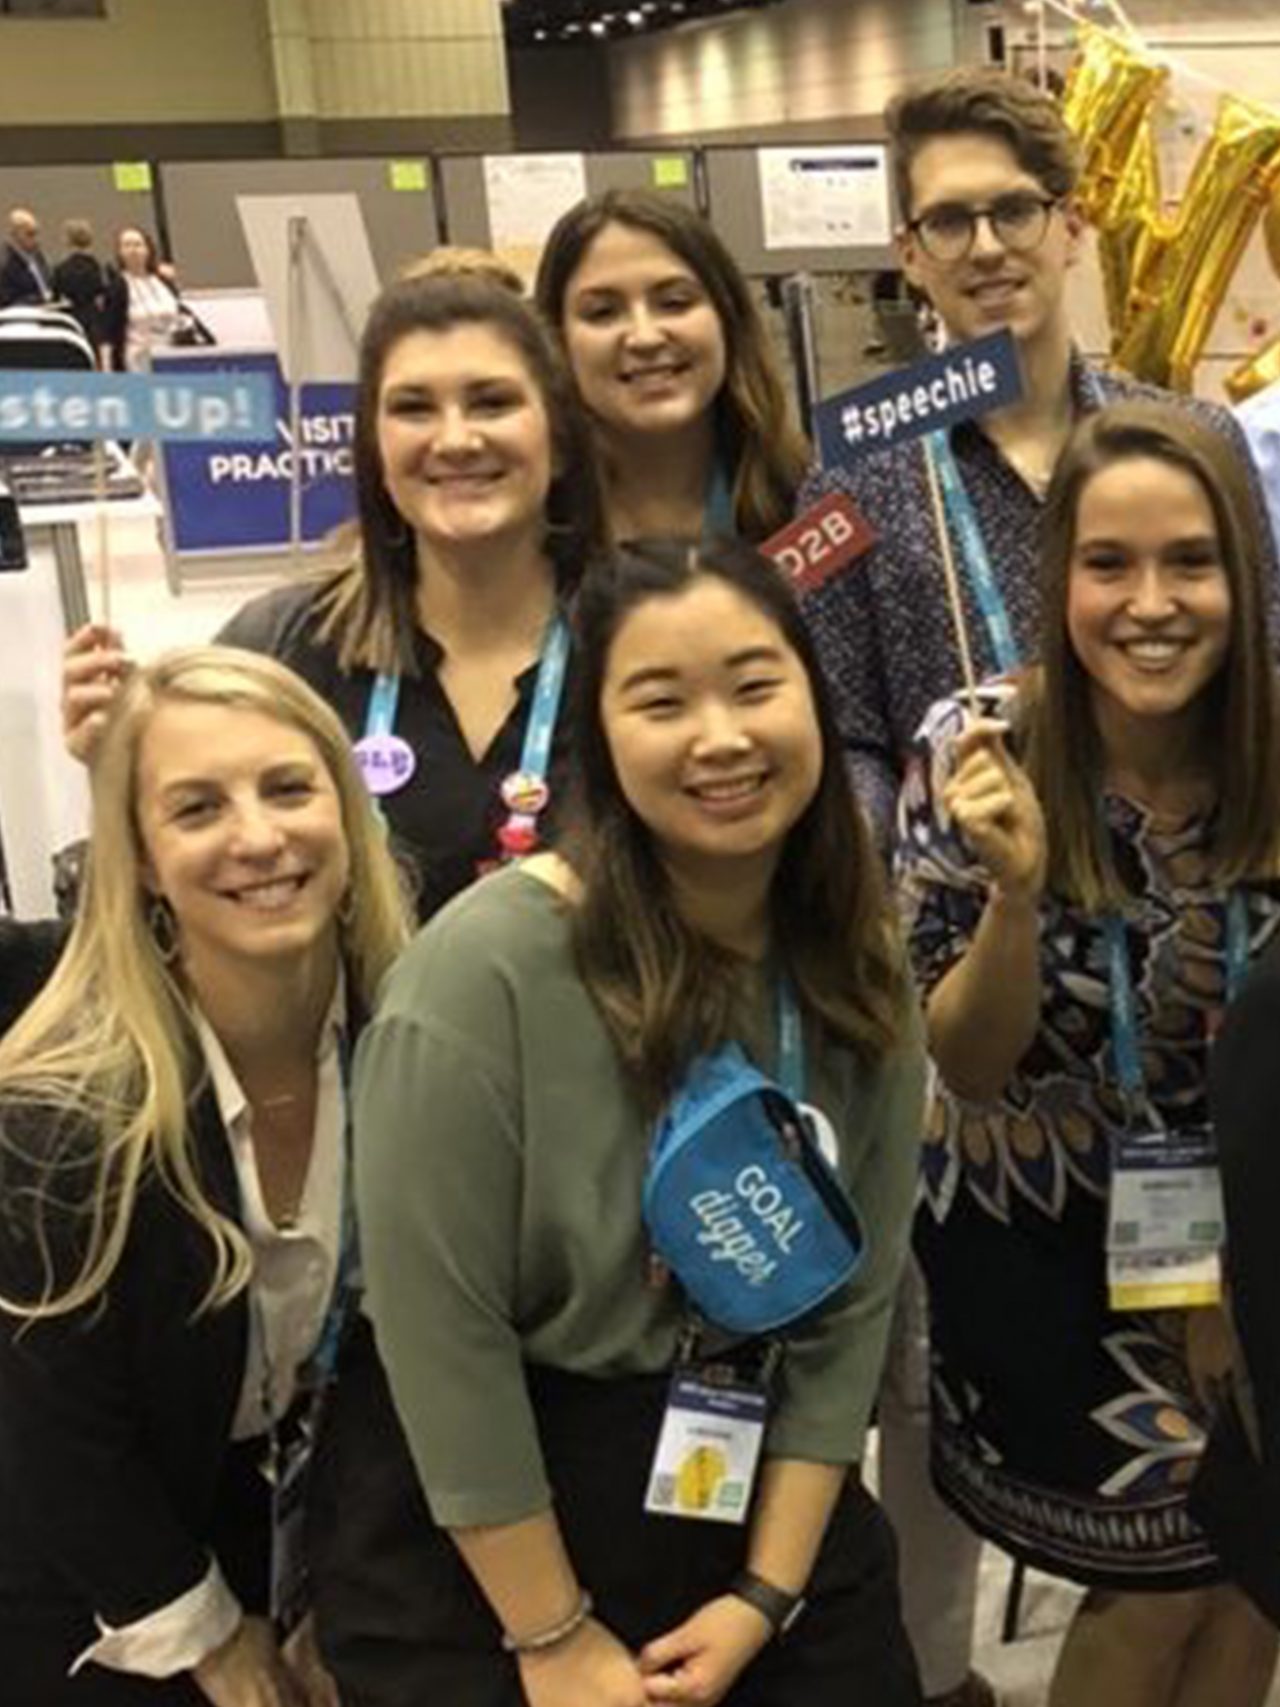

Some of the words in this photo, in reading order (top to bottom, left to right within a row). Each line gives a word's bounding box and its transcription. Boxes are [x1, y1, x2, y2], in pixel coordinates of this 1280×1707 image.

[153, 385, 251, 435] Up!
[840, 357, 997, 445] #speechie
[689, 1189, 779, 1287] digger
[734, 1164, 805, 1255] GOAL
